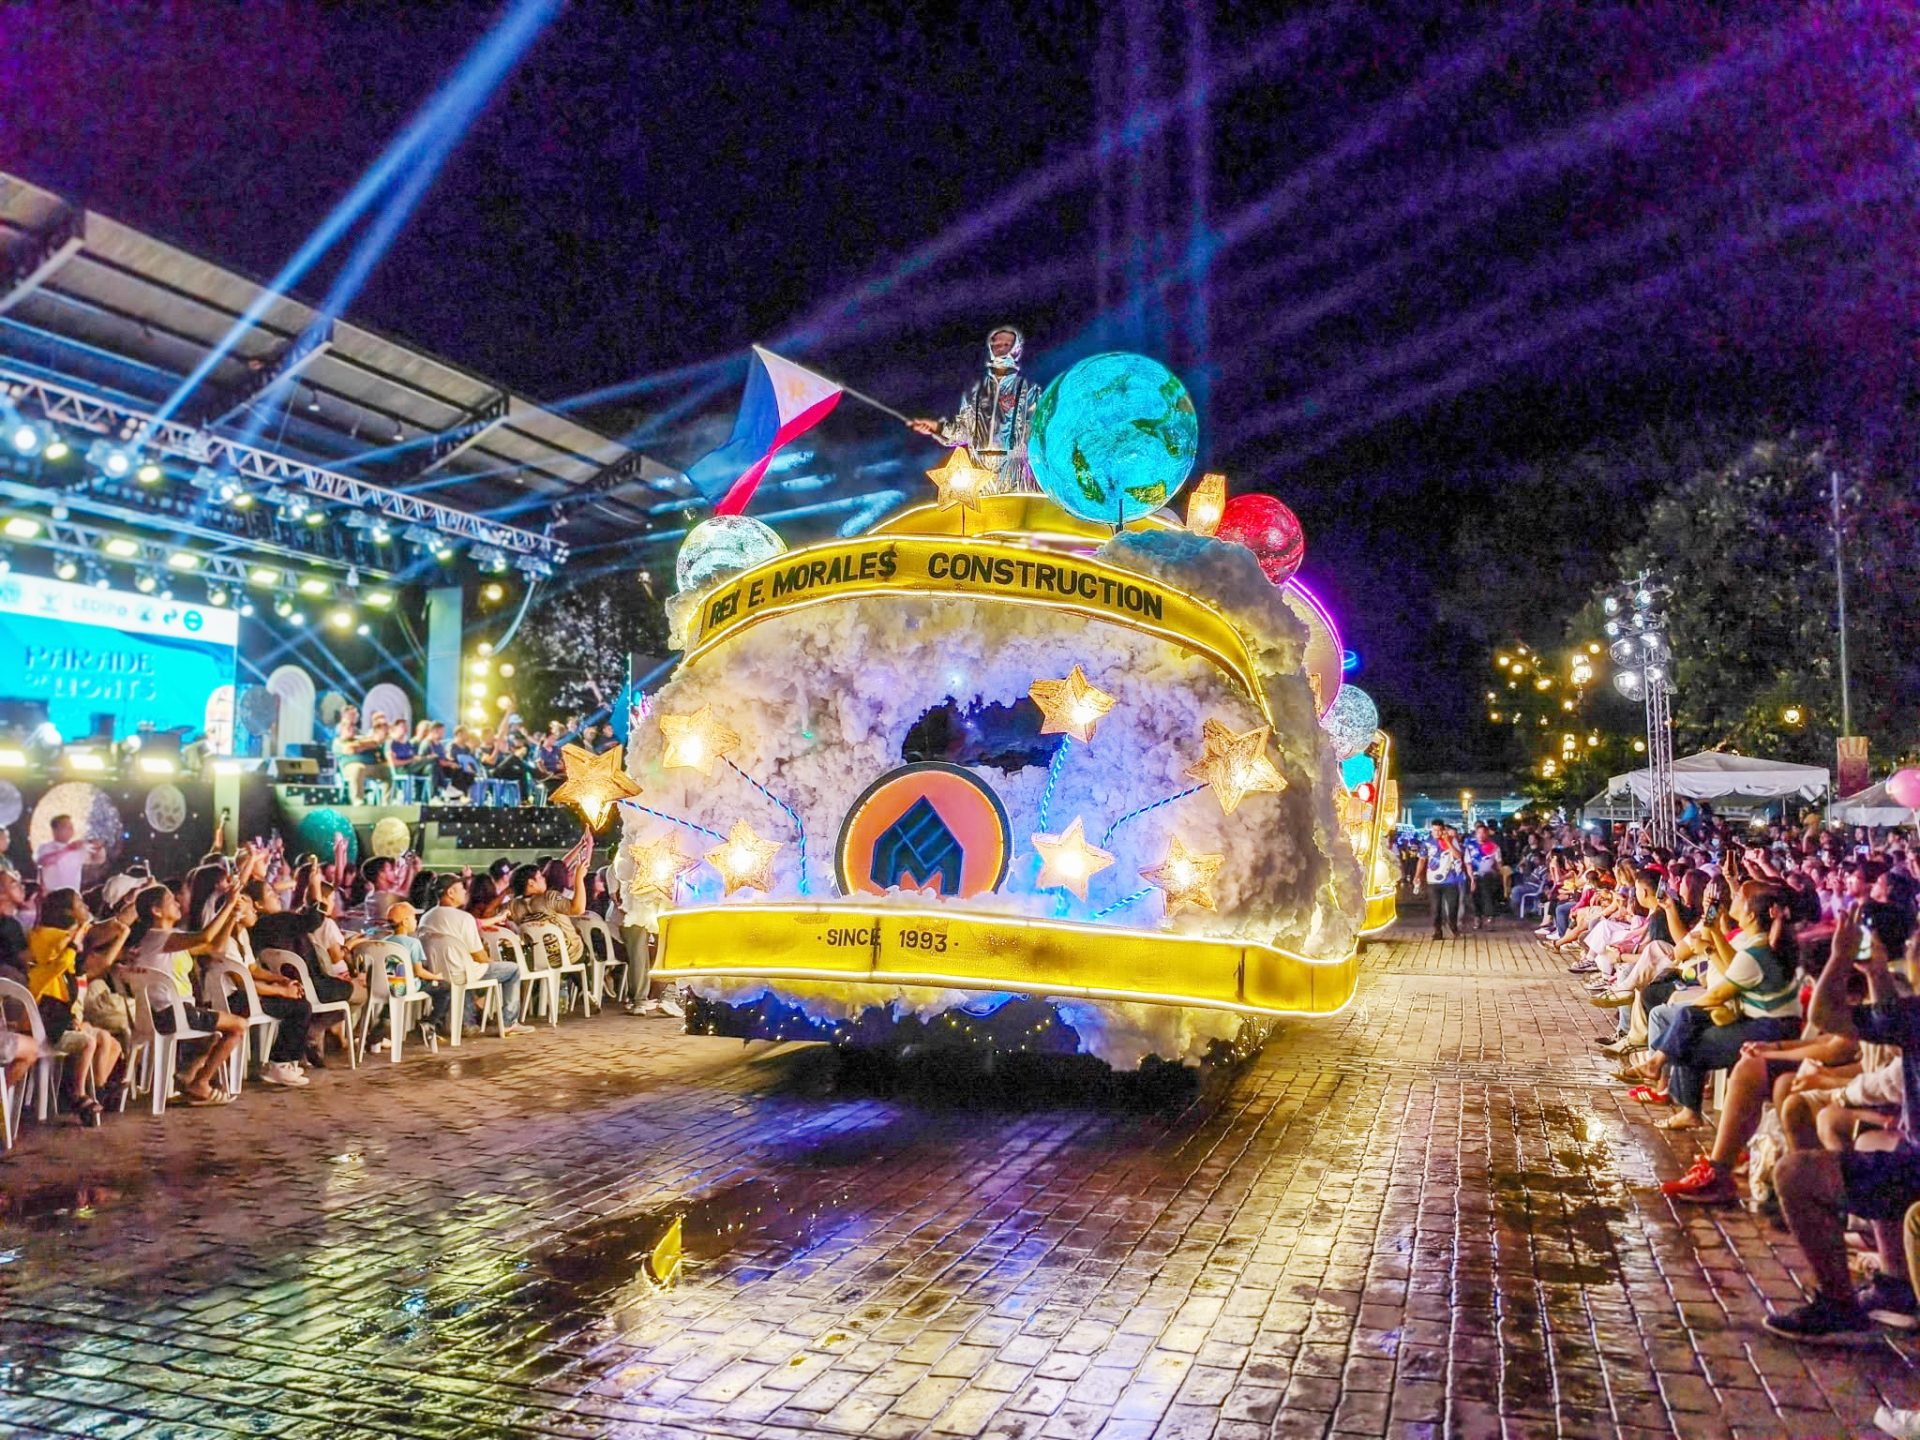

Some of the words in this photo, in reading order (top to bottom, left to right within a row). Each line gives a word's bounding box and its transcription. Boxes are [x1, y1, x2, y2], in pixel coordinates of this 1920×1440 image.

[772, 551, 898, 598] MORALES
[927, 552, 1164, 620] CONSTRUCTION
[826, 928, 882, 947] SINCE
[899, 929, 947, 952] 1993
